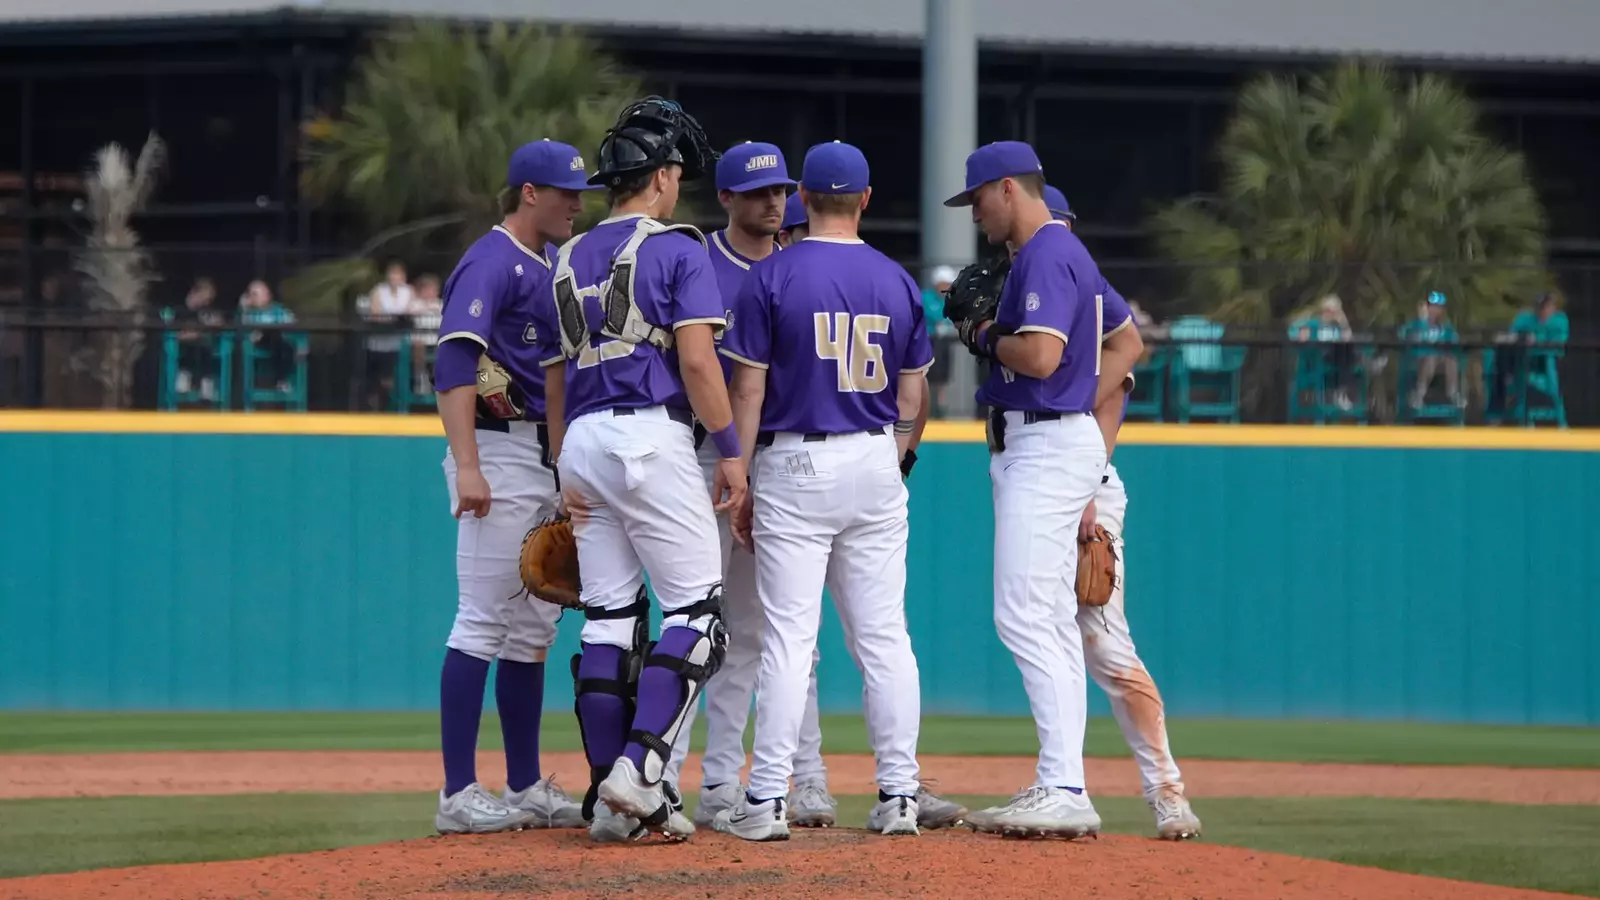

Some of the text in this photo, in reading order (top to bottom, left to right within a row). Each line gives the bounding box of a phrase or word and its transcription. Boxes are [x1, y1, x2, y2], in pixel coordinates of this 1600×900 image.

[570, 156, 585, 171] JM
[745, 155, 778, 172] JMU
[813, 312, 891, 394] 46
